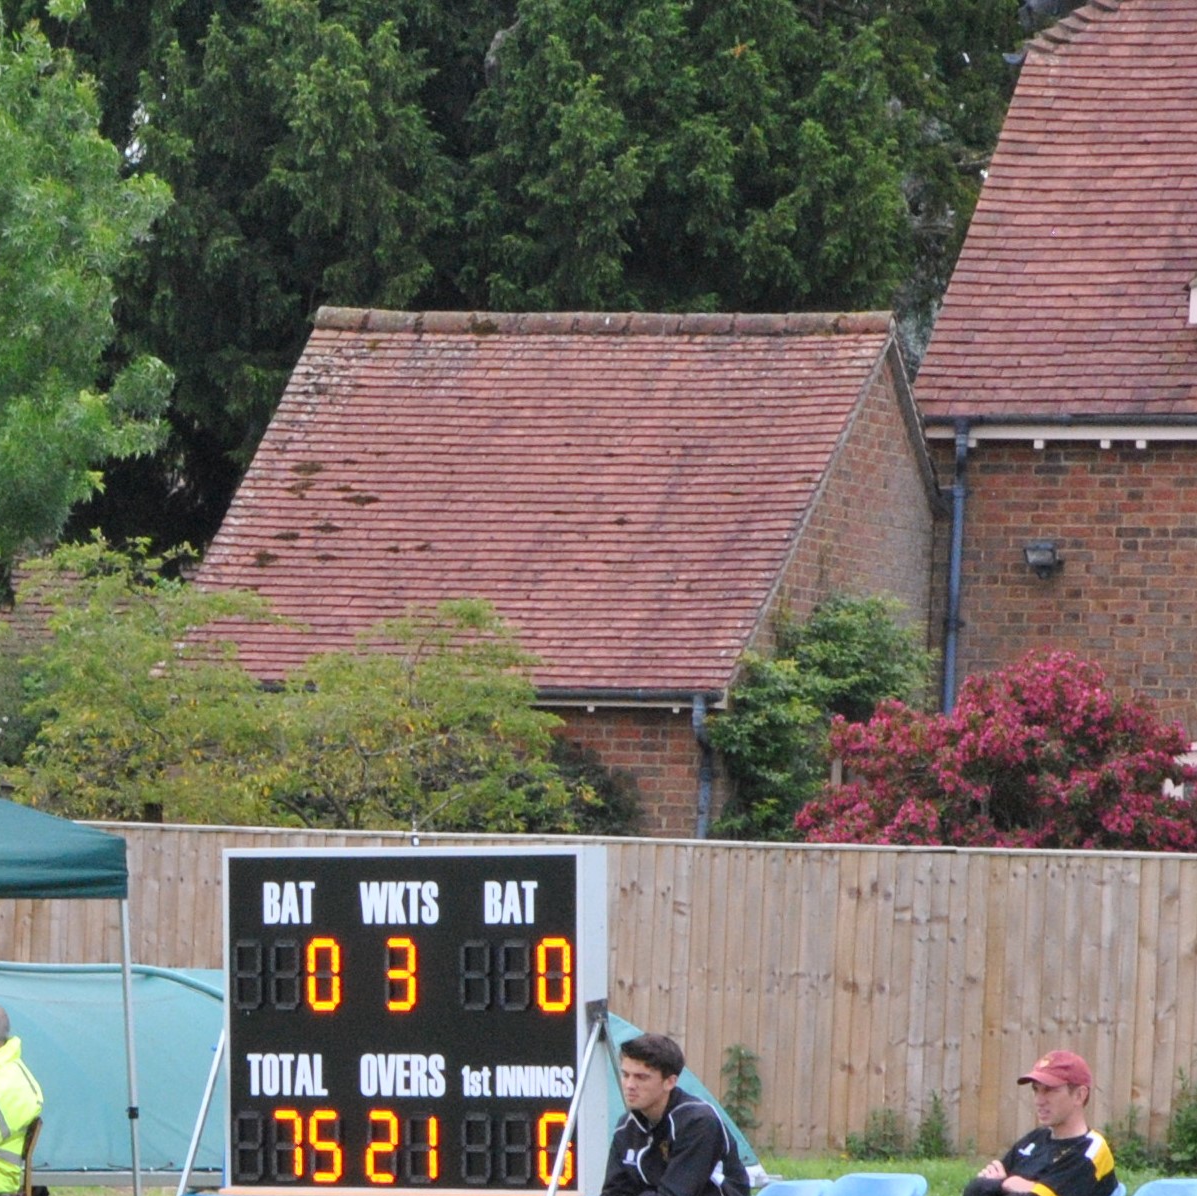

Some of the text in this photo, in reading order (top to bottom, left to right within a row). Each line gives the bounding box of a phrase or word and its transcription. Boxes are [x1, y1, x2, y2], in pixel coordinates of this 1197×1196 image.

[262, 881, 538, 925] BAT WKTS BAT
[306, 937, 572, 1012] 0 3 0
[247, 1053, 574, 1098] TOTAL OVERS 1st INNINGS
[273, 1110, 343, 1183] 75
[365, 1110, 438, 1183] 21
